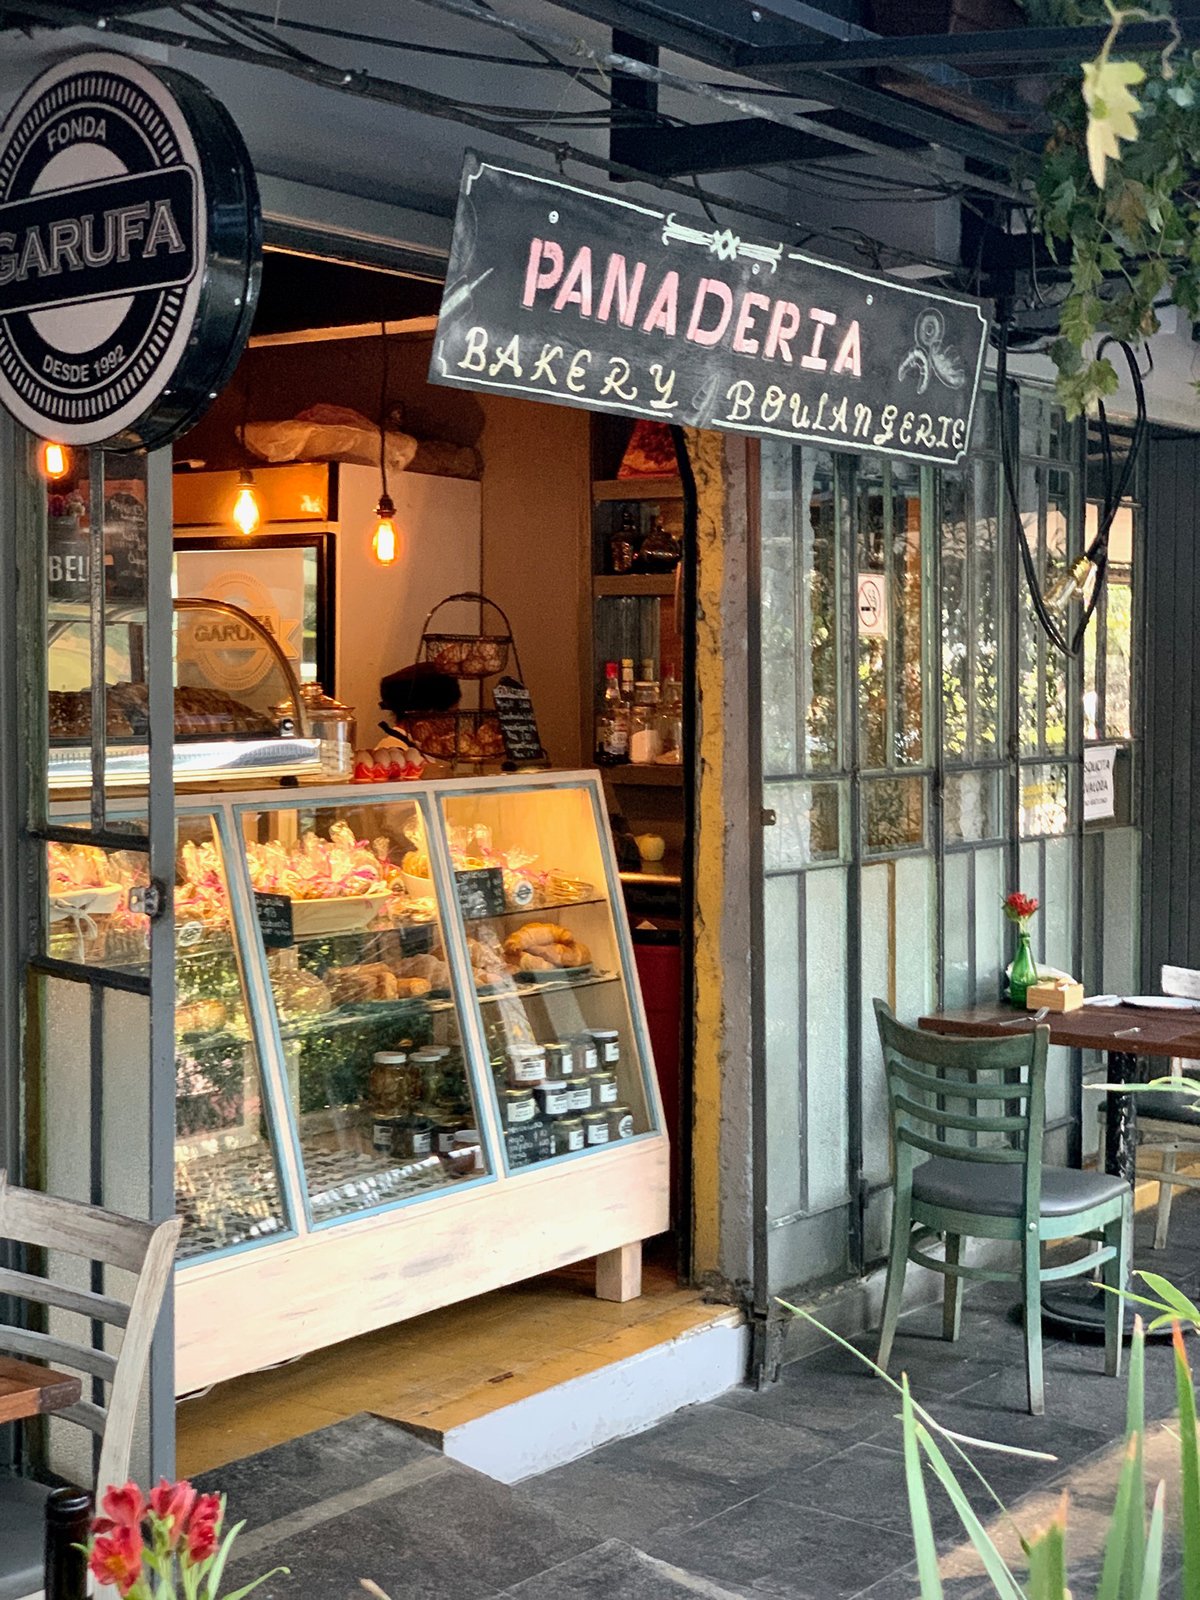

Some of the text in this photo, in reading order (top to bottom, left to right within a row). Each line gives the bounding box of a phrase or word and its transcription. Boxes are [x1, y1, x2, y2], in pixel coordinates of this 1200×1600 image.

[47, 116, 107, 152] FONDA
[0, 199, 186, 284] GARUFA
[521, 236, 863, 378] PANADERIA
[42, 343, 126, 384] DESDE 1992
[458, 325, 679, 410] BAKERY
[726, 378, 967, 451] BOULANGERIE
[48, 555, 90, 582] BEL
